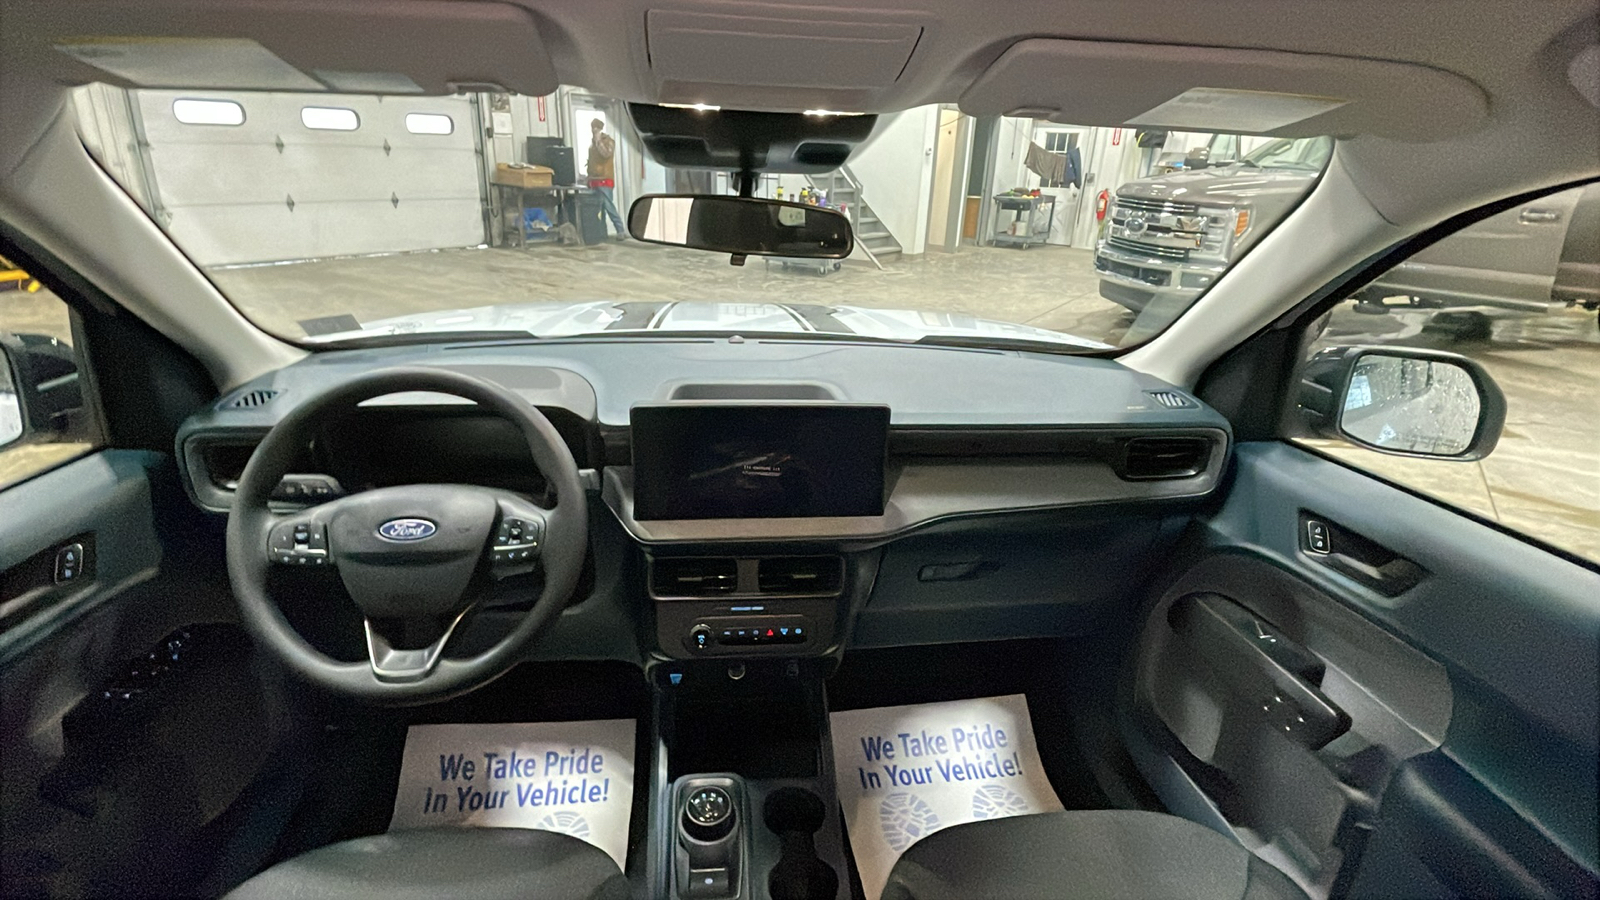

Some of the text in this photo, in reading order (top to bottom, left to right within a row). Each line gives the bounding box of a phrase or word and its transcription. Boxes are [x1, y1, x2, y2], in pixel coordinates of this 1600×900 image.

[389, 521, 426, 537] Ford
[861, 723, 1009, 762] We Take Pride
[440, 748, 604, 782] We Take Pride
[858, 752, 1023, 789] In Your Vehicle!
[423, 778, 610, 814] In Your Vehicle!
